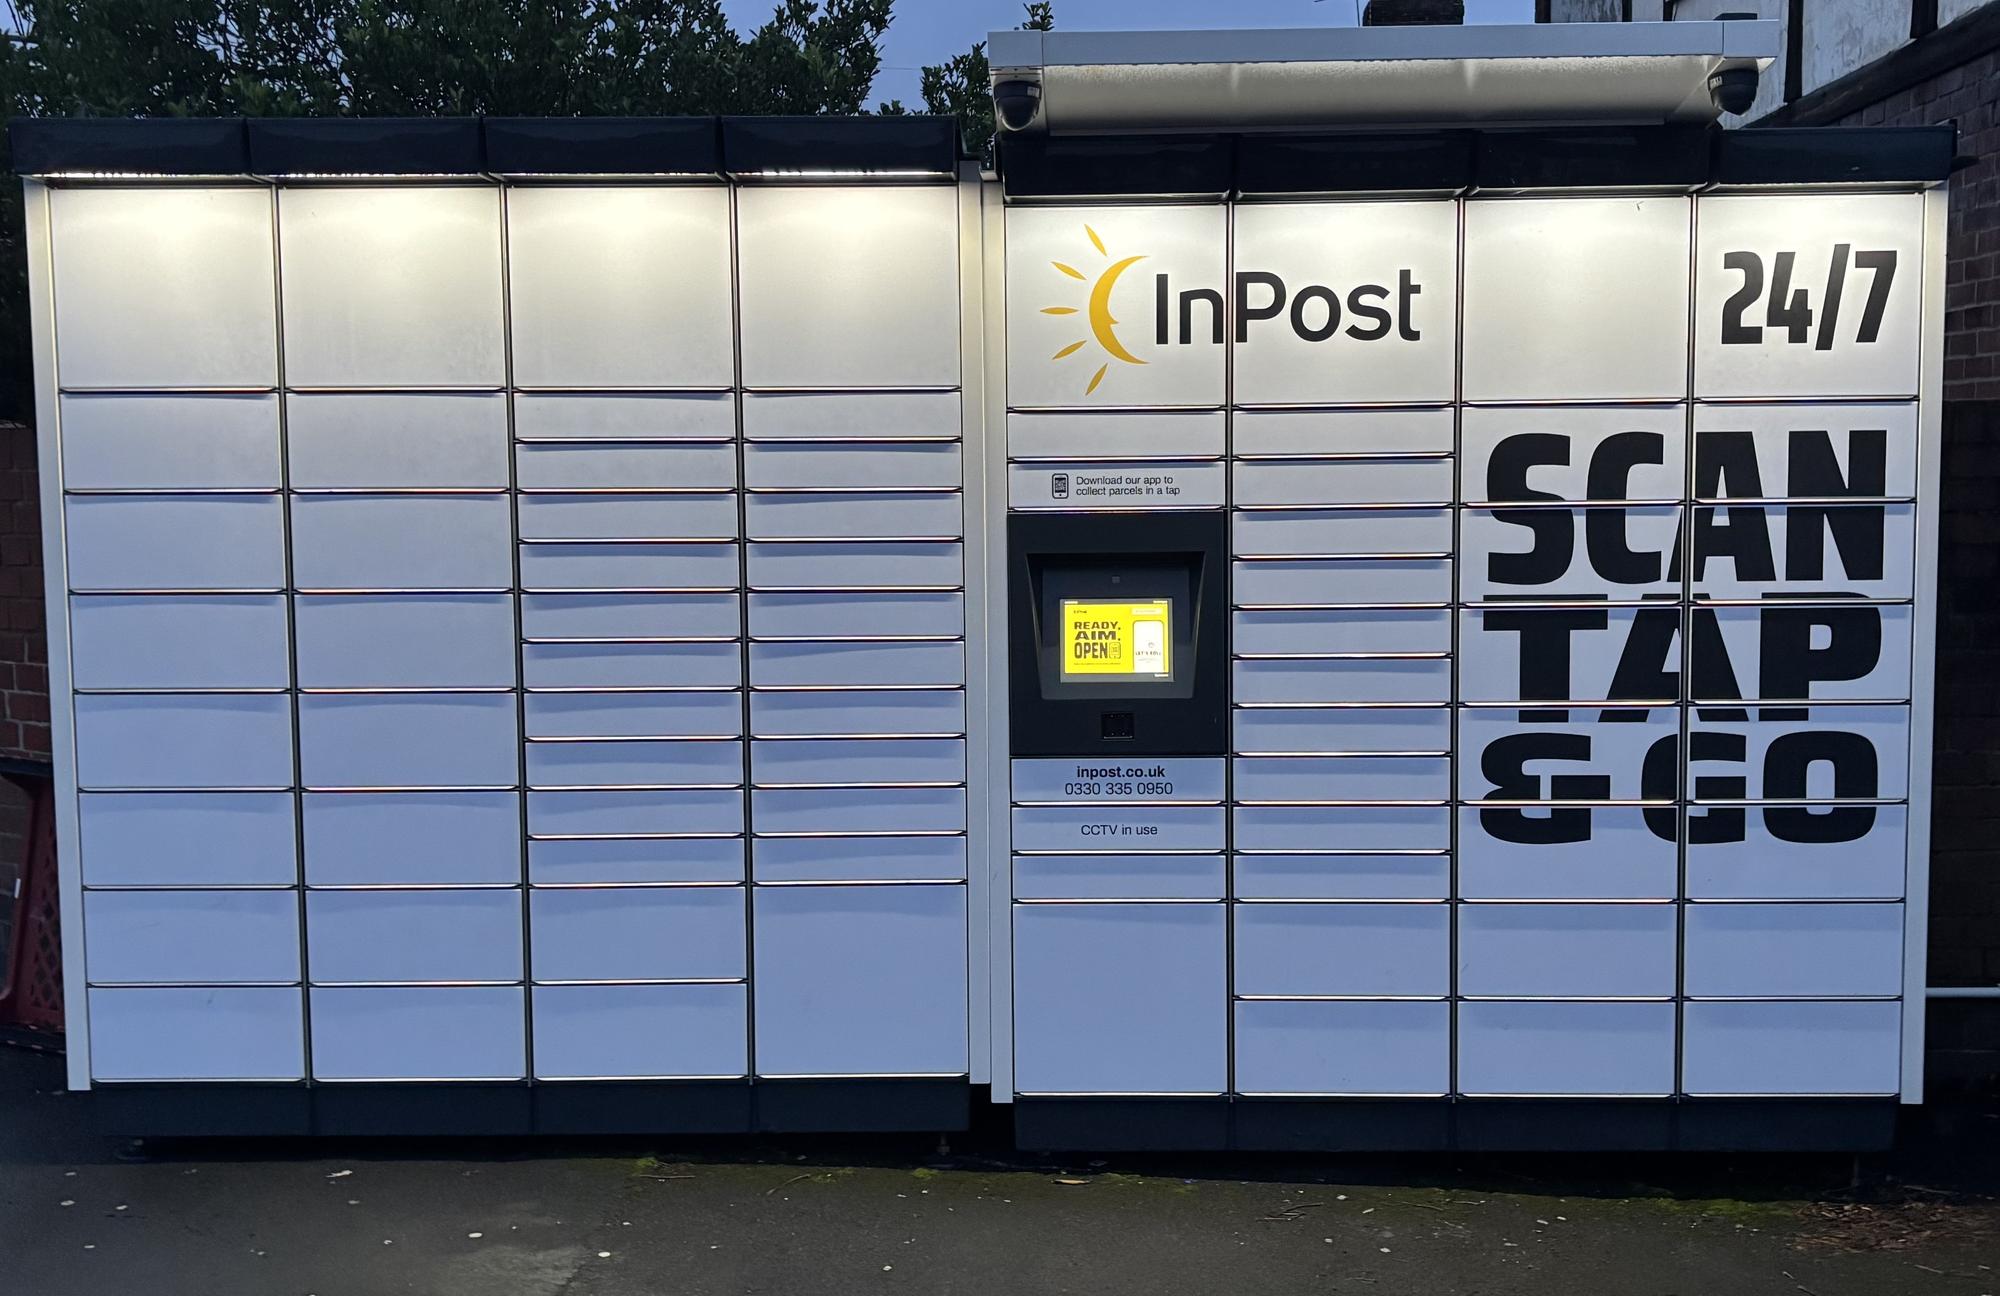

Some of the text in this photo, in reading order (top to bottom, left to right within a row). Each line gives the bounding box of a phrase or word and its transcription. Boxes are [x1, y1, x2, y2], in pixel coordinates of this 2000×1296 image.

[1721, 243, 1898, 351] 24/7
[1156, 269, 1421, 345] InPost
[1076, 476, 1173, 486] Download our app to
[1076, 485, 1180, 496] collect parcels in a tap
[1486, 430, 1887, 585] SCAN
[1074, 642, 1108, 659] OPEN
[1483, 592, 1882, 723] TAP
[1077, 765, 1165, 780] inpost.co.uk
[1065, 783, 1173, 795] 0330 335 0950
[1480, 731, 1878, 844] & GO
[1081, 824, 1158, 836] CCTV in use
